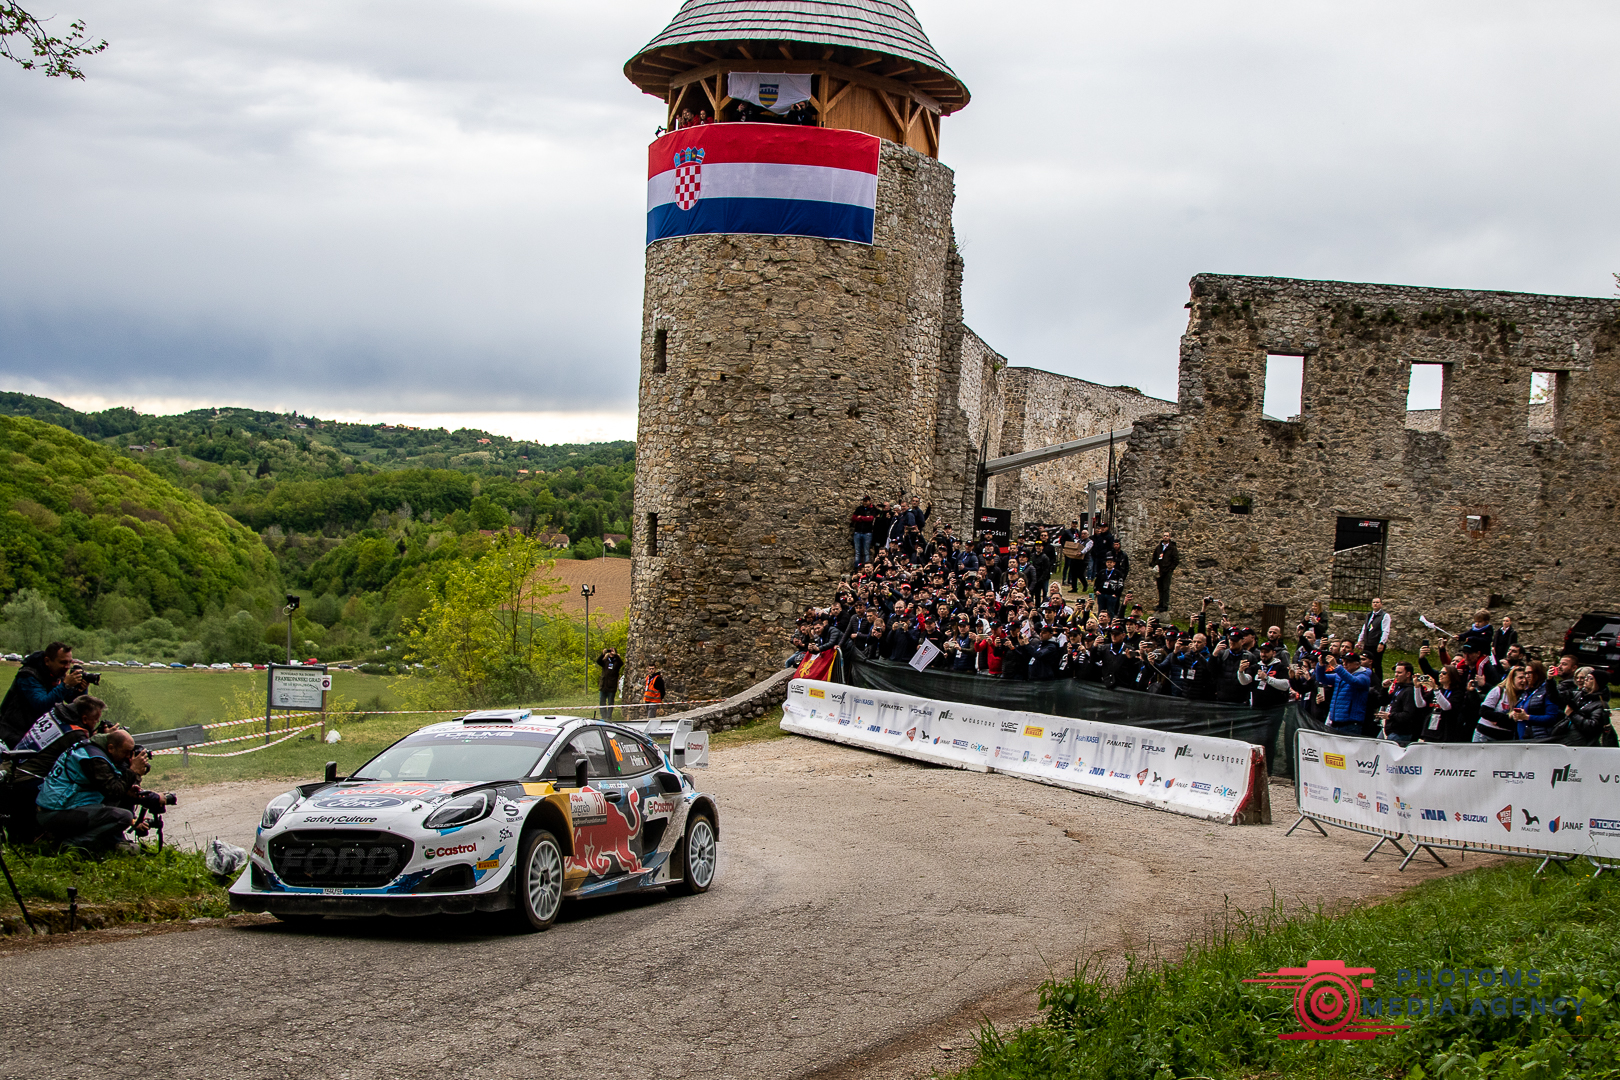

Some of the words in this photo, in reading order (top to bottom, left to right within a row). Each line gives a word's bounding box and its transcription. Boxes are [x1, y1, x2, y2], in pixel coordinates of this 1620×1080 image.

[880, 703, 904, 712] FANATEC
[968, 717, 996, 728] CASTORE
[434, 731, 515, 739] FORUM8
[1106, 739, 1133, 749] FANATEC
[1141, 744, 1166, 753] FORUM8
[609, 738, 623, 762] 16
[1211, 754, 1245, 766] CASTORE
[1325, 754, 1344, 768] PIRELLI
[1113, 771, 1132, 780] SUZUKI
[1433, 768, 1477, 778] FANATEC
[1492, 770, 1536, 780] FORUM8
[330, 788, 379, 797] Red
[378, 788, 431, 797] Bull
[326, 798, 391, 808] Ford
[653, 800, 675, 816] Castrol
[303, 815, 378, 825] SafetyCulture
[1462, 813, 1488, 824] SUZUKI
[1561, 821, 1584, 831] JANAF
[436, 842, 477, 858] Castrol
[280, 846, 399, 876] FORD
[478, 861, 498, 869] PIRELLI
